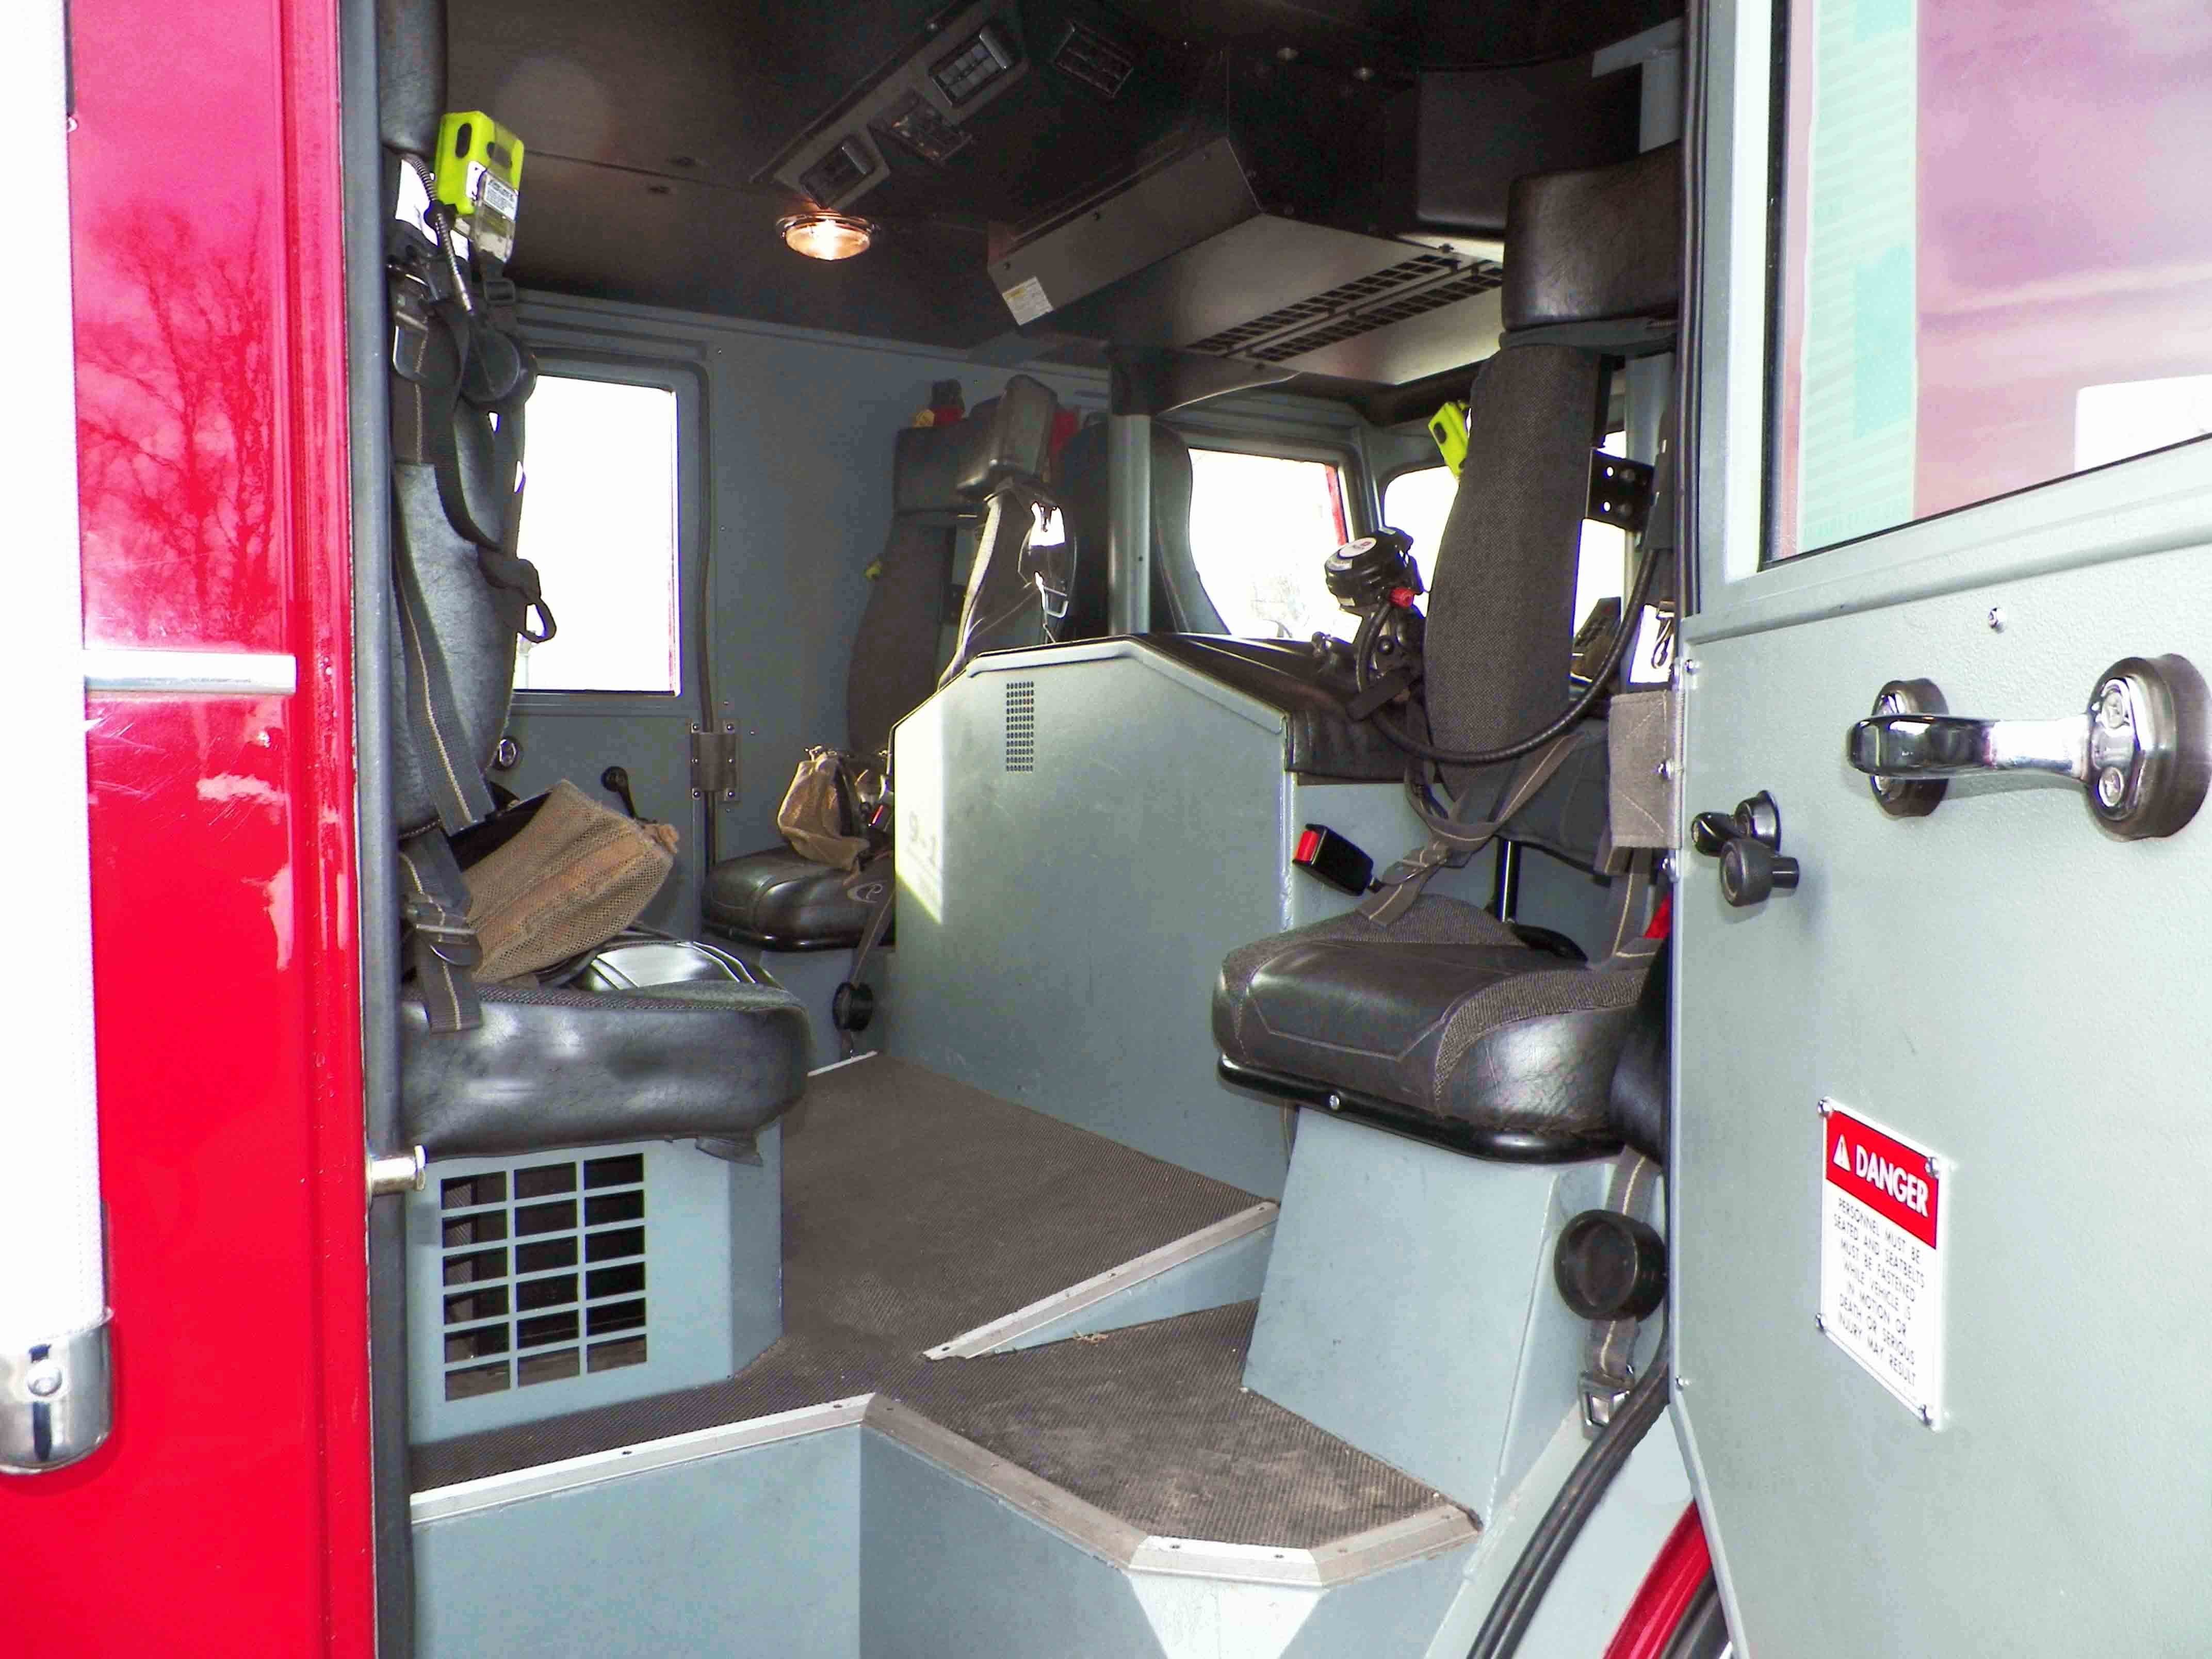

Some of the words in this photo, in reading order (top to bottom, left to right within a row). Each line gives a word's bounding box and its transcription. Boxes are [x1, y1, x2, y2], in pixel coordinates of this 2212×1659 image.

[1856, 1144, 1928, 1218] DANGER
[1834, 1213, 1858, 1241] SEATED
[1863, 1235, 1879, 1256] AND
[1885, 1248, 1924, 1288] SEATBELTS
[1839, 1197, 1879, 1237] PERSONNEL
[1885, 1228, 1905, 1253] MUST
[1911, 1246, 1920, 1264] BE
[1841, 1238, 1859, 1260] MUST
[1864, 1254, 1872, 1271] BE
[1878, 1262, 1914, 1302] FASTENED
[1843, 1258, 1864, 1286] WHILE
[1869, 1278, 1898, 1311] VEHICLE
[1840, 1293, 1862, 1322] DEATH
[1867, 1316, 1877, 1335] OR
[1883, 1327, 1915, 1364] SERIOUS
[1860, 1289, 1890, 1324] MOTION
[1896, 1318, 1907, 1337] OR
[1839, 1311, 1862, 1340] INJURY
[1867, 1334, 1884, 1359] MAY
[1890, 1354, 1916, 1387] RESULT
